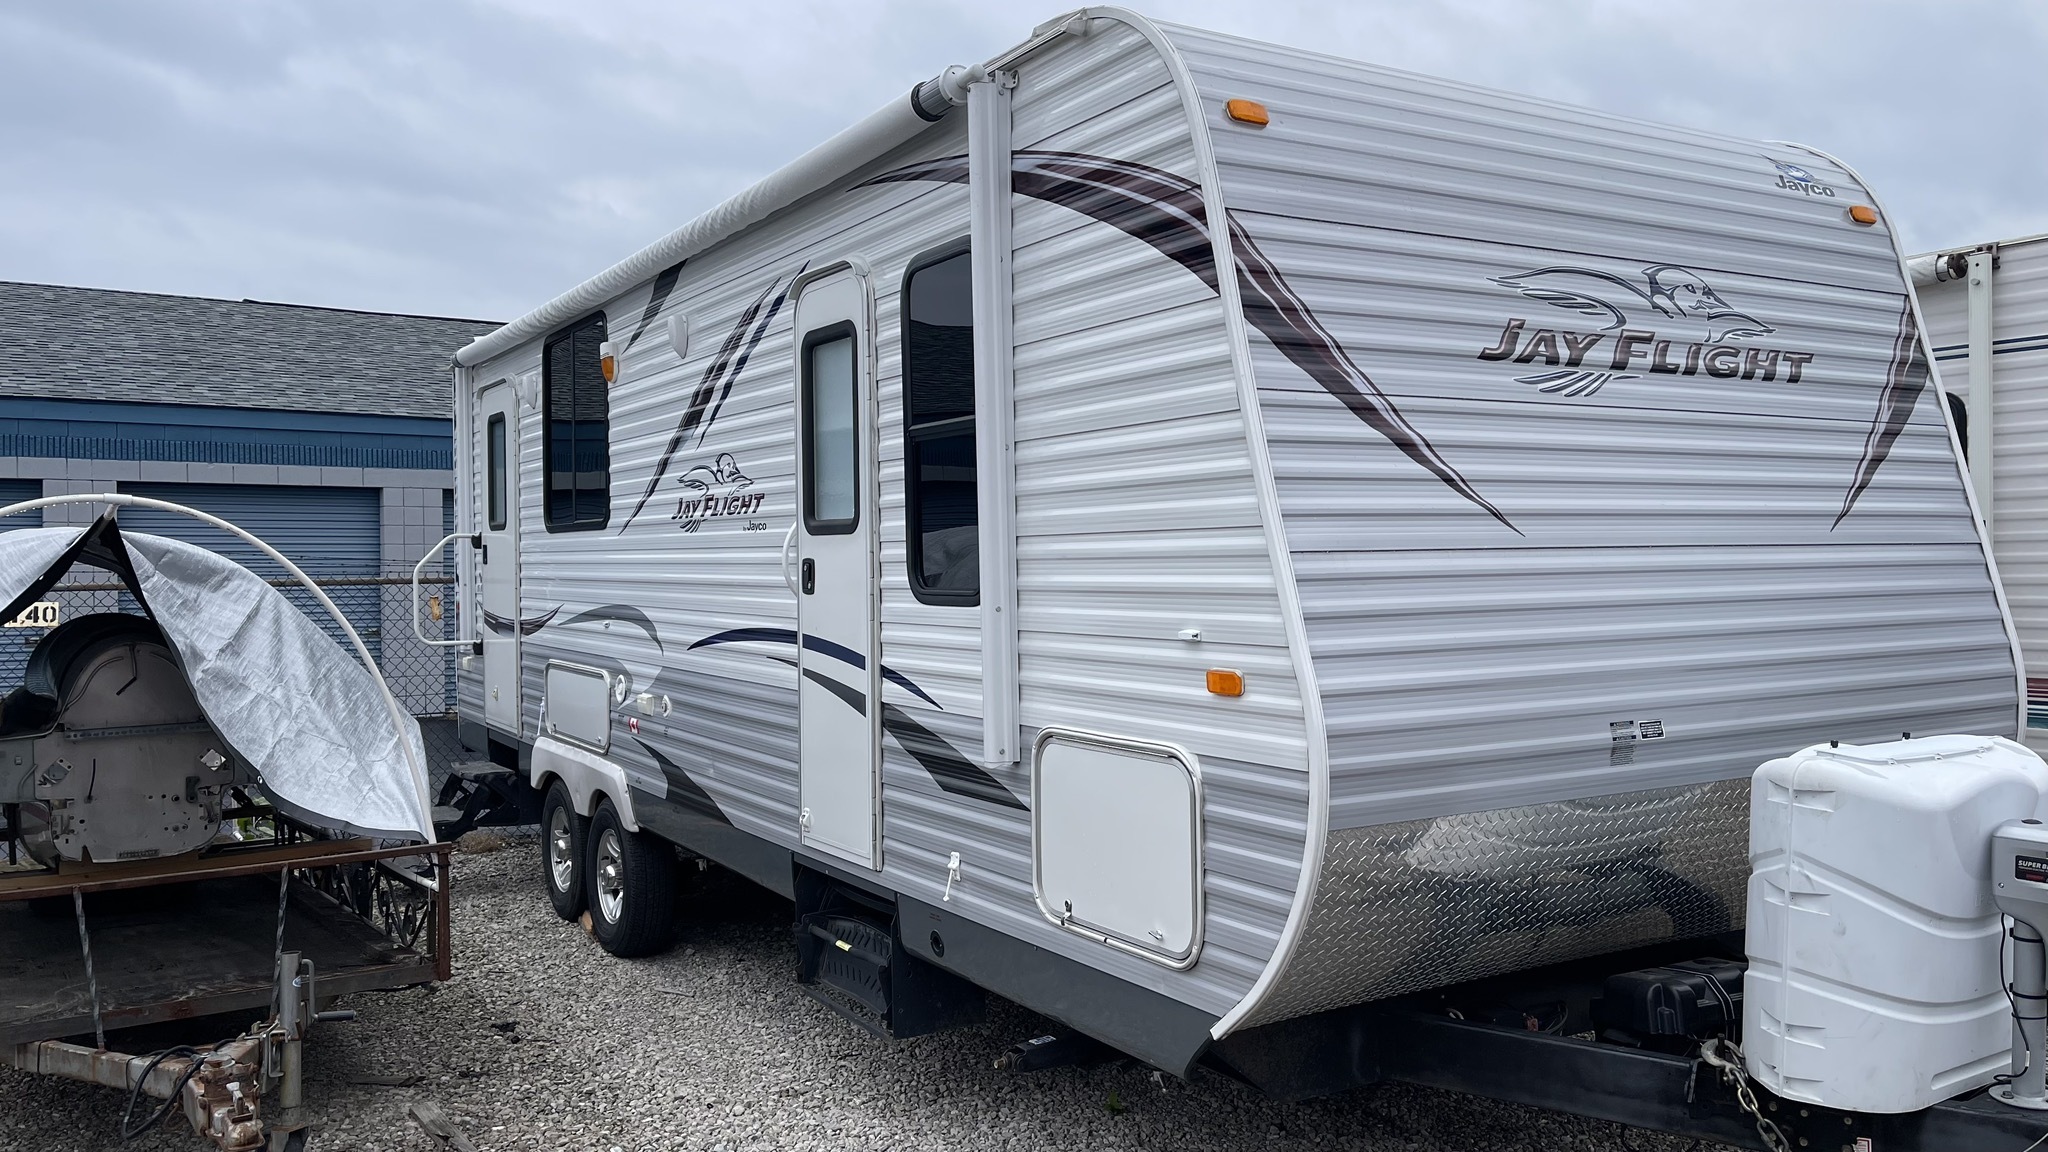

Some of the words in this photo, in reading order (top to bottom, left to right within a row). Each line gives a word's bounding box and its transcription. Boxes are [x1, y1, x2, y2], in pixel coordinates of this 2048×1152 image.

[1774, 174, 1836, 198] Jayco
[747, 520, 767, 533] Jayco
[2018, 860, 2042, 869] SUPER
